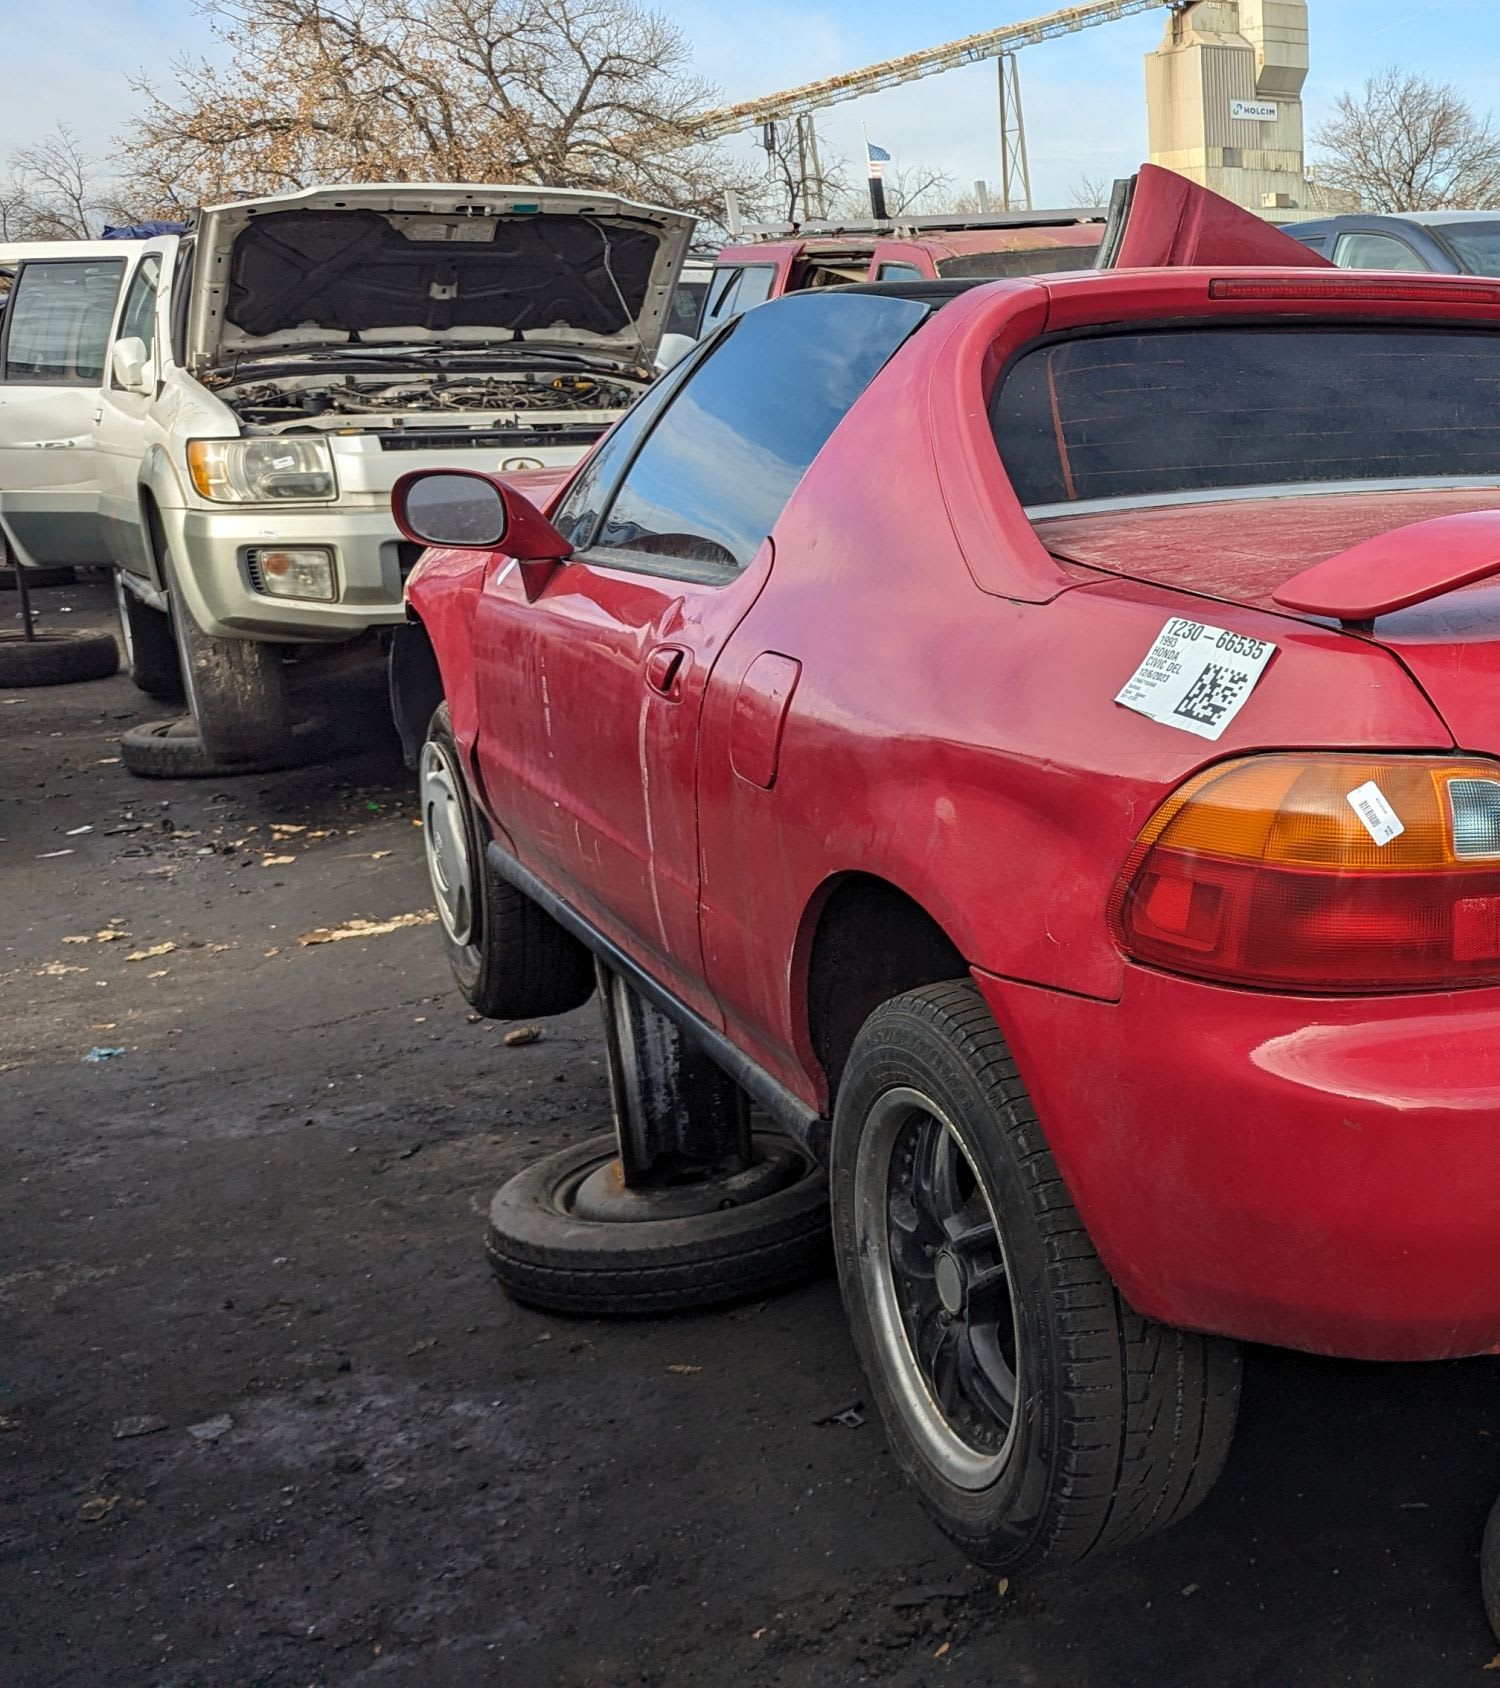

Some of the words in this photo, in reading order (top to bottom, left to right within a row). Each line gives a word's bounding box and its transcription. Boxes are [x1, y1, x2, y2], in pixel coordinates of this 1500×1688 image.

[1244, 106, 1275, 116] HOLCIM
[1160, 635, 1179, 648] 1993
[1167, 619, 1267, 660] 1230-66535
[1152, 645, 1180, 661] HONDA
[1145, 656, 1167, 670] CIVIC
[1165, 661, 1182, 675] DEL
